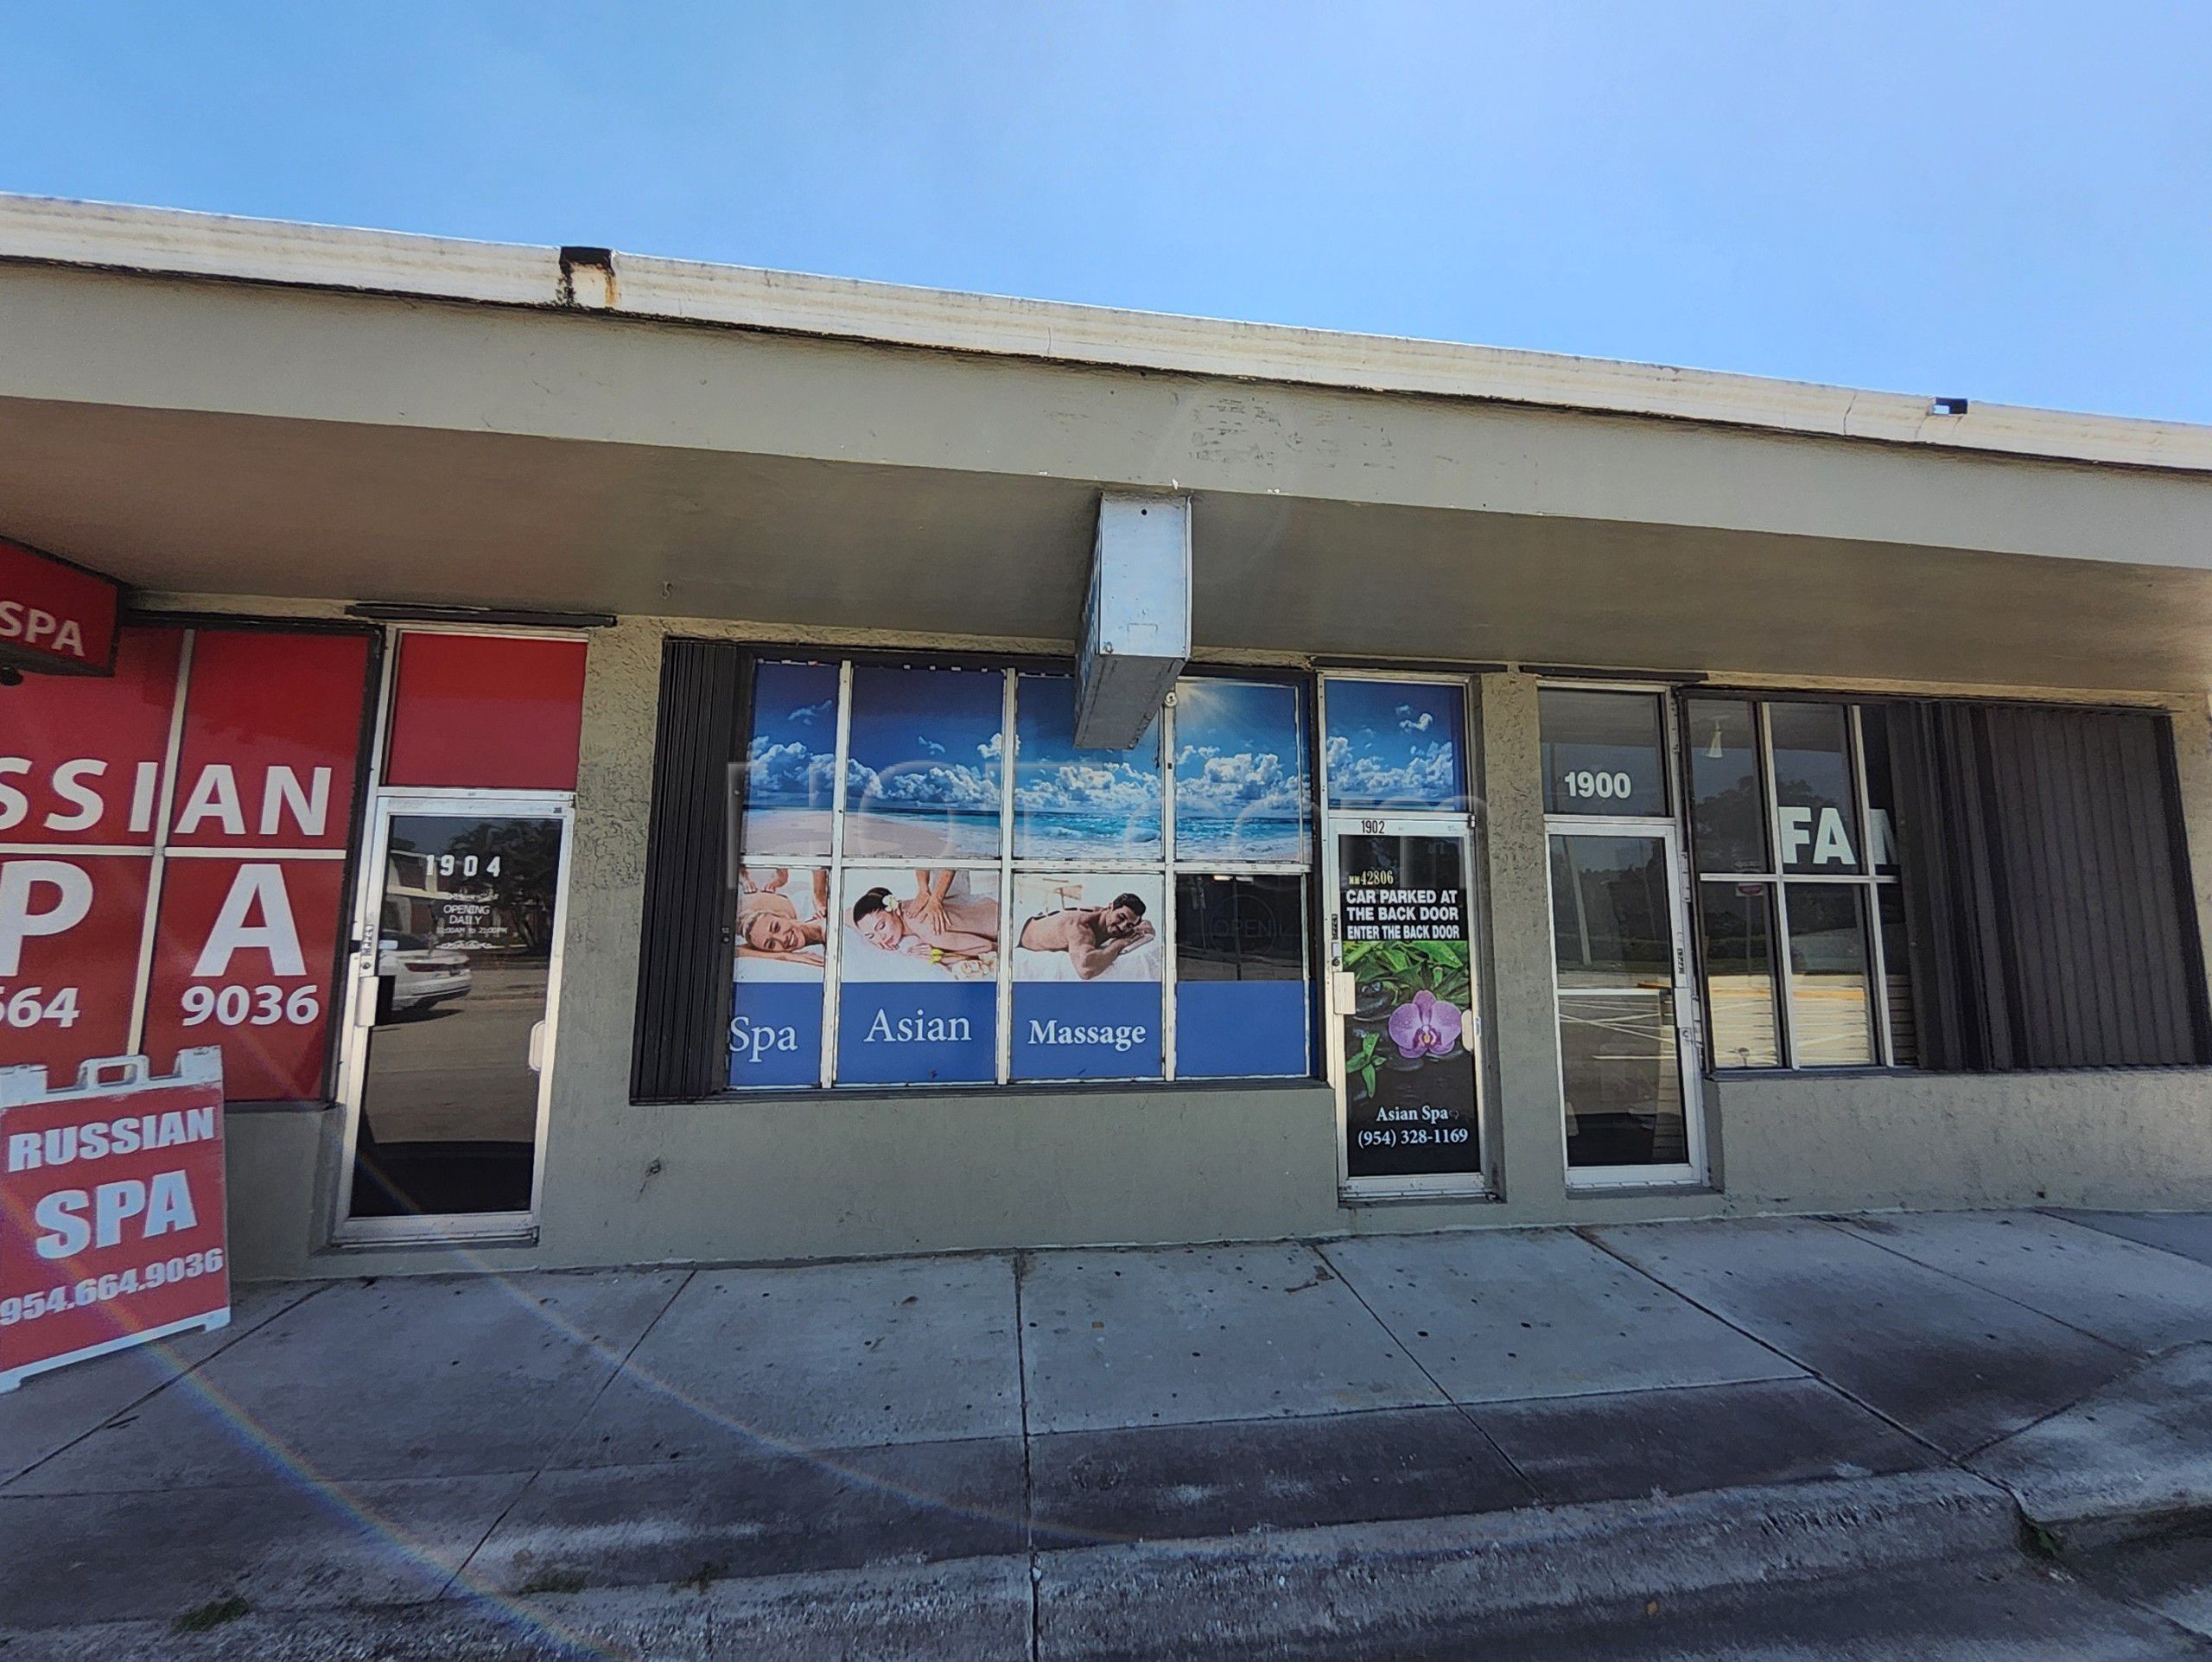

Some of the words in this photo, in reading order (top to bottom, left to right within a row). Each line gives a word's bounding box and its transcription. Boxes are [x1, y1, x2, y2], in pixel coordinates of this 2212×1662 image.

[0, 601, 86, 657] SPA
[1564, 771, 1631, 799] 1900
[1361, 820, 1385, 834] 1902
[425, 855, 501, 876] 1904
[1346, 889, 1376, 904] CAR
[1380, 889, 1436, 904] PARKED
[1440, 890, 1458, 903] AT
[443, 904, 491, 914] OPENING
[1347, 907, 1375, 921] THE
[1378, 907, 1416, 921] BACK
[1420, 907, 1459, 920] DOOR
[449, 915, 482, 925] DAILY
[1347, 925, 1380, 939] ENTER
[1382, 925, 1402, 939] THE
[1403, 925, 1430, 939] BACK
[1432, 925, 1460, 939] DOOR
[0, 986, 79, 1028] 64
[181, 984, 320, 1026] 9036
[728, 1016, 798, 1063] Spa
[863, 1009, 972, 1042] Asian
[1027, 1019, 1147, 1052] Massage
[1376, 1105, 1418, 1122] Asian
[1422, 1105, 1449, 1124] Spa
[8, 1106, 214, 1172] RUSSIAN
[1357, 1129, 1397, 1149] (954)
[1401, 1128, 1468, 1144] 328-1169
[35, 1168, 198, 1259] SPA
[0, 1248, 224, 1325] 954.664.9036
